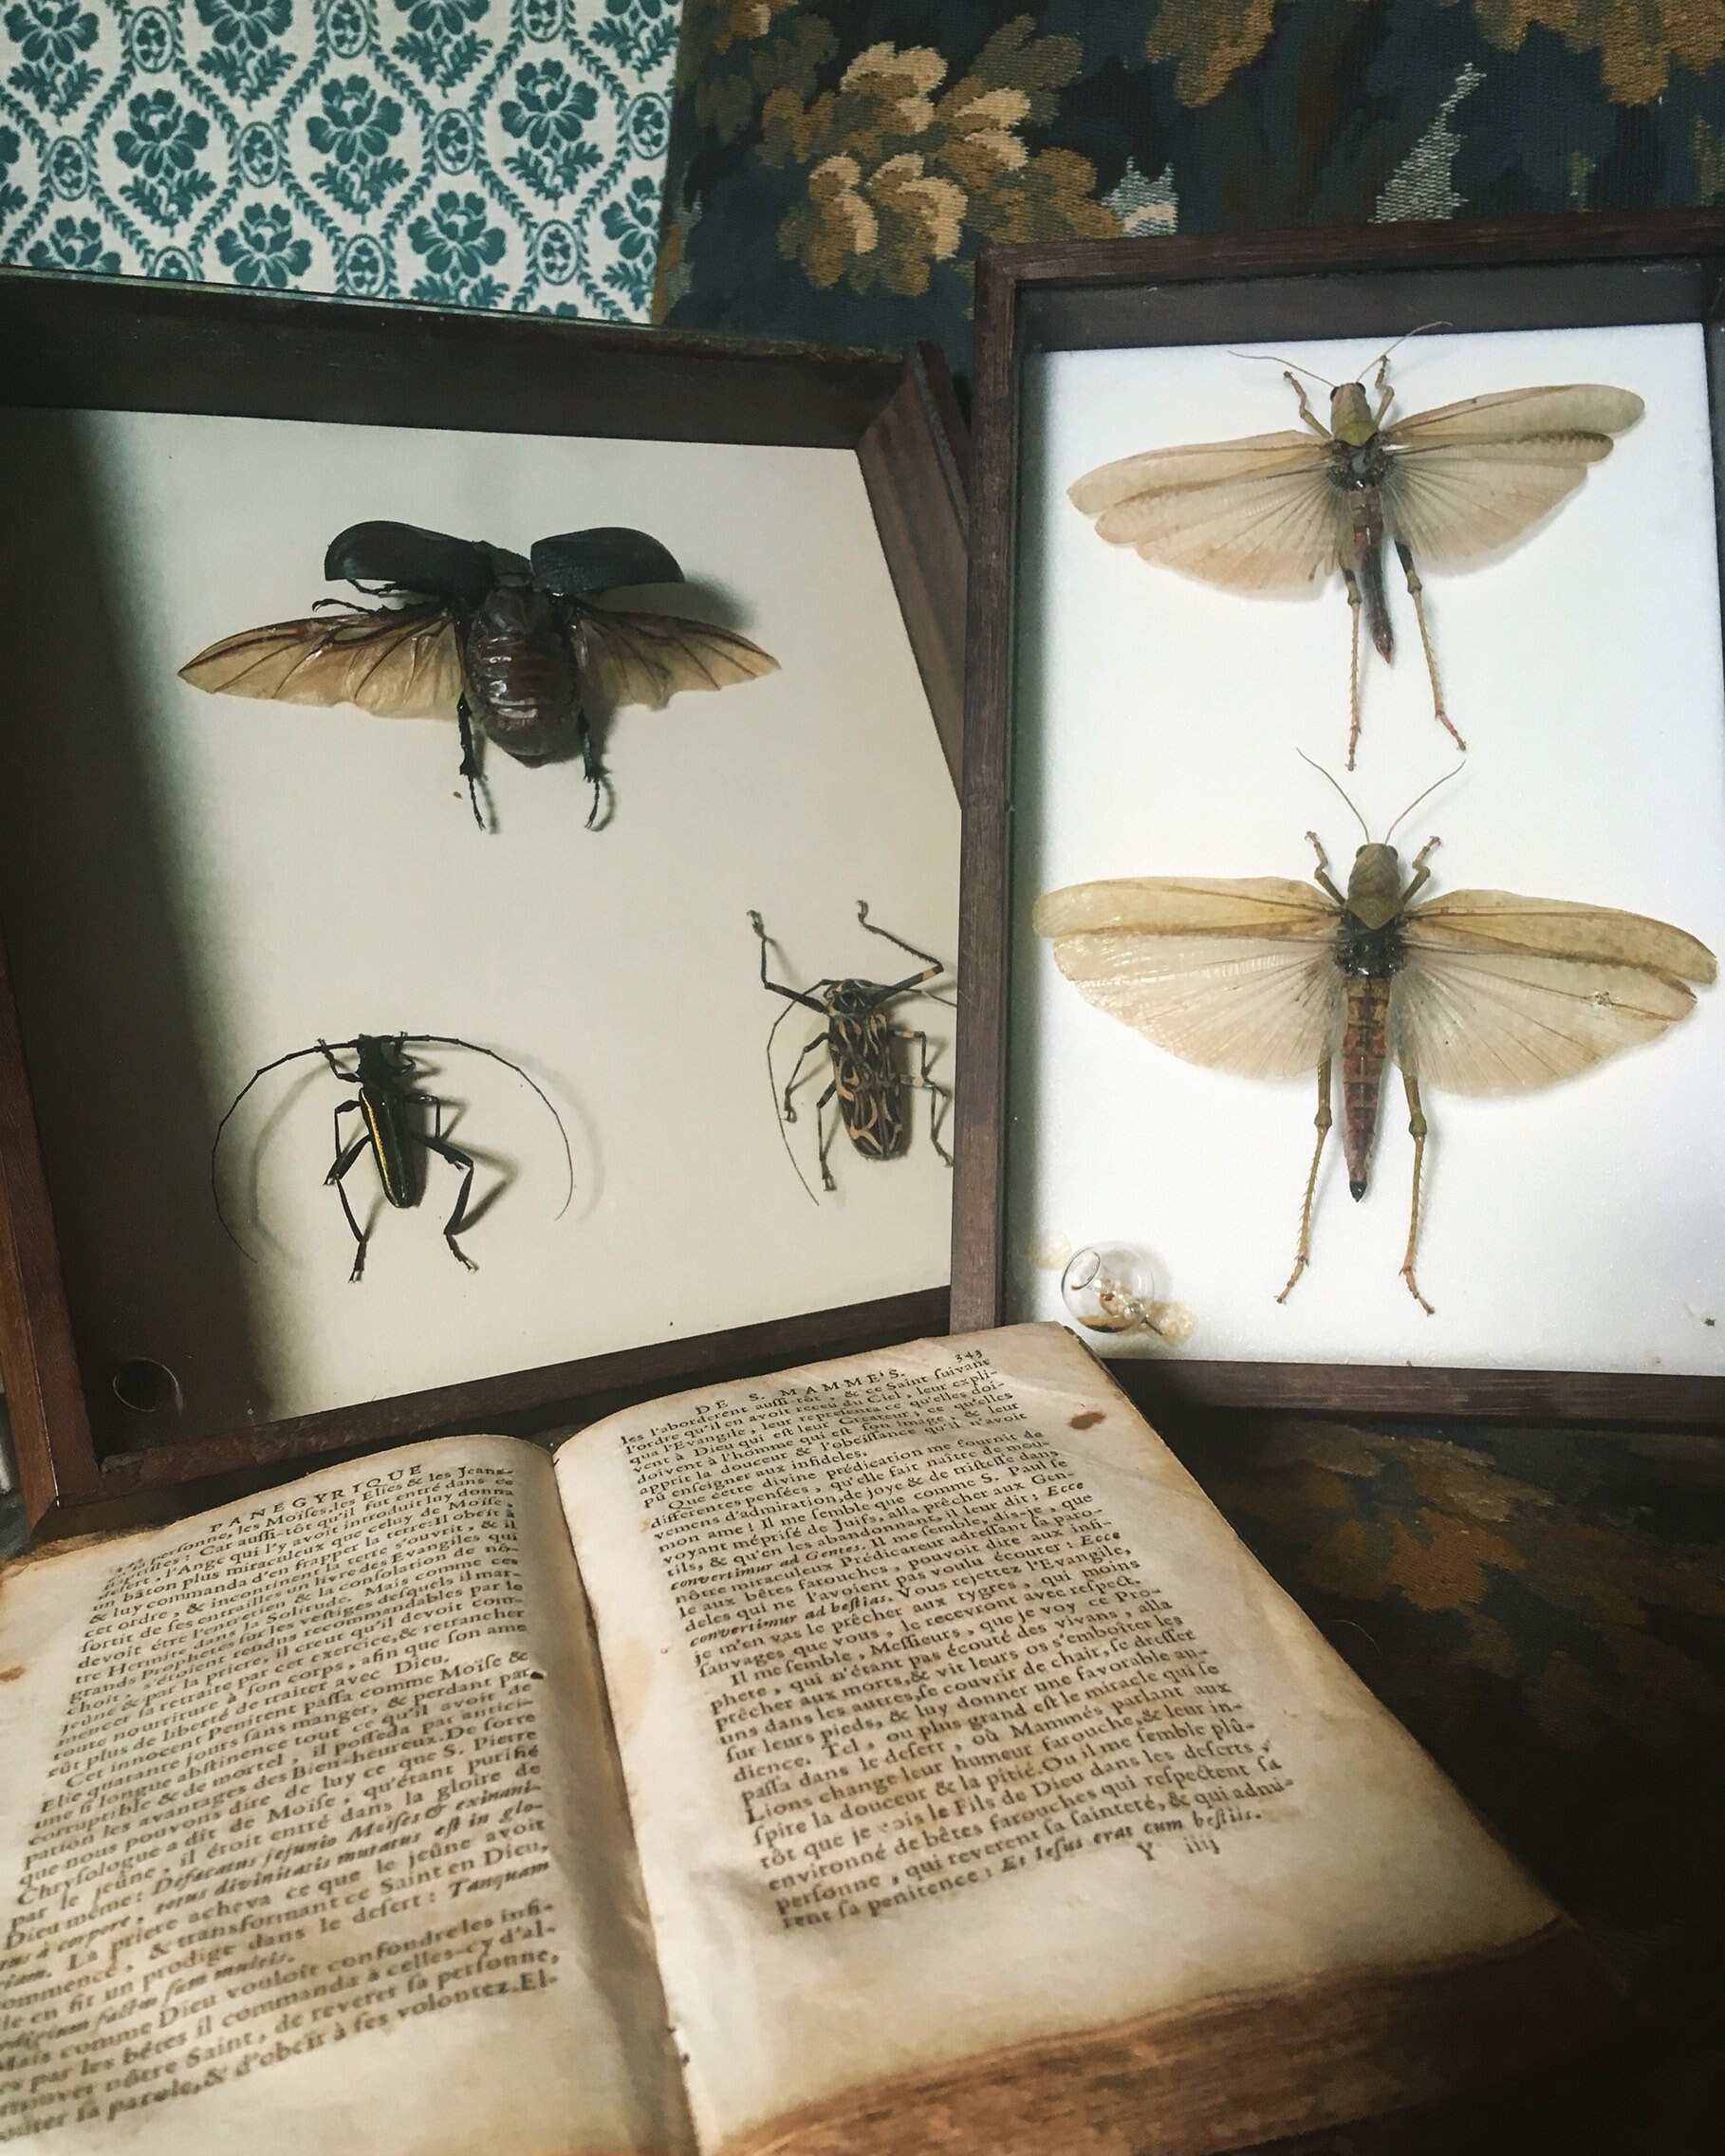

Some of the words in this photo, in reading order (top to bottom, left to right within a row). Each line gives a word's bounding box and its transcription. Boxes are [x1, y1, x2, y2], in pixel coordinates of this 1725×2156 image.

[626, 1434, 679, 1455] l'ordre
[684, 1422, 721, 1439] qu'il
[724, 1419, 744, 1428] en
[843, 1399, 863, 1408] du
[916, 1384, 947, 1395] leur
[640, 1475, 692, 1496] apprit
[696, 1471, 713, 1480] la
[720, 1452, 788, 1475] douceur
[924, 1419, 962, 1435] qu'il
[762, 1473, 817, 1489] divine
[825, 1449, 923, 1480] prédication
[927, 1443, 952, 1454] me
[956, 1433, 1018, 1448] fournit
[1023, 1429, 1043, 1440] de
[165, 1556, 225, 1578] l'Ange
[230, 1546, 259, 1565] qui
[266, 1542, 288, 1554] l'y
[343, 1500, 422, 1531] introduit
[426, 1493, 453, 1505] luy
[209, 1464, 421, 1533] PANEGYRIQUE
[658, 1534, 700, 1553] mon
[760, 1516, 774, 1530] Il
[780, 1515, 807, 1526] me
[874, 1496, 905, 1512] que
[914, 1479, 976, 1500] comme
[1007, 1459, 1048, 1477] Paul
[662, 1543, 728, 1564] voyant
[807, 1524, 828, 1535] de
[922, 1490, 989, 1515] prêcher
[992, 1482, 1026, 1496] aux
[733, 1548, 783, 1567] qu'en
[787, 1541, 812, 1552] les
[944, 1508, 960, 1521] il
[962, 1502, 997, 1515] leur
[1047, 1482, 1084, 1497] Ecce
[107, 1648, 187, 1678] Hermite
[193, 1629, 236, 1649] dans
[243, 1621, 260, 1635] la
[364, 1578, 409, 1597] Mais
[415, 1559, 481, 1581] comme
[492, 1556, 519, 1566] ces
[113, 1604, 143, 1618] luy
[146, 1578, 248, 1609] commanda
[251, 1568, 288, 1584] d'en
[295, 1543, 359, 1571] frapper
[365, 1536, 380, 1547] la
[685, 1613, 732, 1633] deles
[736, 1602, 768, 1621] qui
[772, 1600, 796, 1611] ne
[806, 1579, 891, 1604] l'avoient
[895, 1571, 926, 1589] pas
[930, 1557, 985, 1576] voulu
[1080, 1532, 1121, 1547] Ecce
[690, 1614, 798, 1647] convertimur
[805, 1605, 826, 1620] ad
[895, 1582, 948, 1599] Vous
[952, 1566, 1022, 1587] rejettez
[695, 1650, 711, 1667] je
[718, 1637, 766, 1655] m'en
[768, 1630, 803, 1645] vas
[806, 1623, 825, 1636] le
[831, 1608, 902, 1635] prêcher
[912, 1597, 947, 1613] aux
[1041, 1570, 1072, 1588] qui
[1081, 1560, 1140, 1580] moins
[141, 1684, 176, 1710] par
[183, 1678, 199, 1690] la
[275, 1645, 288, 1659] il
[294, 1632, 344, 1653] creut
[350, 1616, 393, 1640] qu'il
[400, 1602, 462, 1624] devoit
[714, 1699, 793, 1734] prêcher
[800, 1690, 838, 1707] aux
[936, 1663, 967, 1678] vit
[968, 1650, 1019, 1670] leurs
[1026, 1643, 1048, 1655] os
[1052, 1620, 1153, 1652] s'emboîter
[1152, 1614, 1182, 1627] les
[85, 1746, 128, 1772] plus
[133, 1736, 157, 1750] de
[162, 1707, 229, 1742] liberté
[235, 1701, 259, 1715] de
[264, 1682, 327, 1705] traiter
[335, 1670, 380, 1688] avec
[762, 1733, 815, 1754] leurs
[914, 1703, 948, 1719] luy
[956, 1685, 1029, 1709] donner
[1033, 1675, 1072, 1693] une
[1076, 1649, 1171, 1682] favorable
[744, 1797, 813, 1826] Lions
[819, 1775, 899, 1803] change
[900, 1762, 943, 1783] leur
[951, 1744, 1033, 1771] humeur
[1162, 1703, 1206, 1719] leur
[803, 1835, 844, 1861] que
[852, 1827, 871, 1847] je
[926, 1803, 950, 1822] le
[953, 1794, 995, 1817] Fils
[1001, 1789, 1028, 1806] de
[1029, 1773, 1085, 1798] Dieu
[1090, 1756, 1141, 1777] dans
[1141, 1749, 1176, 1769] les
[18, 1864, 60, 1891] que
[64, 1843, 118, 1870] nous
[229, 1795, 270, 1815] dire
[285, 1783, 311, 1799] de
[322, 1773, 356, 1790] luy
[362, 1764, 386, 1778] ce
[399, 1752, 436, 1776] que
[473, 1731, 537, 1752] Pierre
[1136, 1840, 1155, 1863] Y
[1143, 1819, 1185, 1835] cum
[285, 1884, 311, 1900] ce
[318, 1870, 361, 1896] que
[376, 1859, 396, 1874] le
